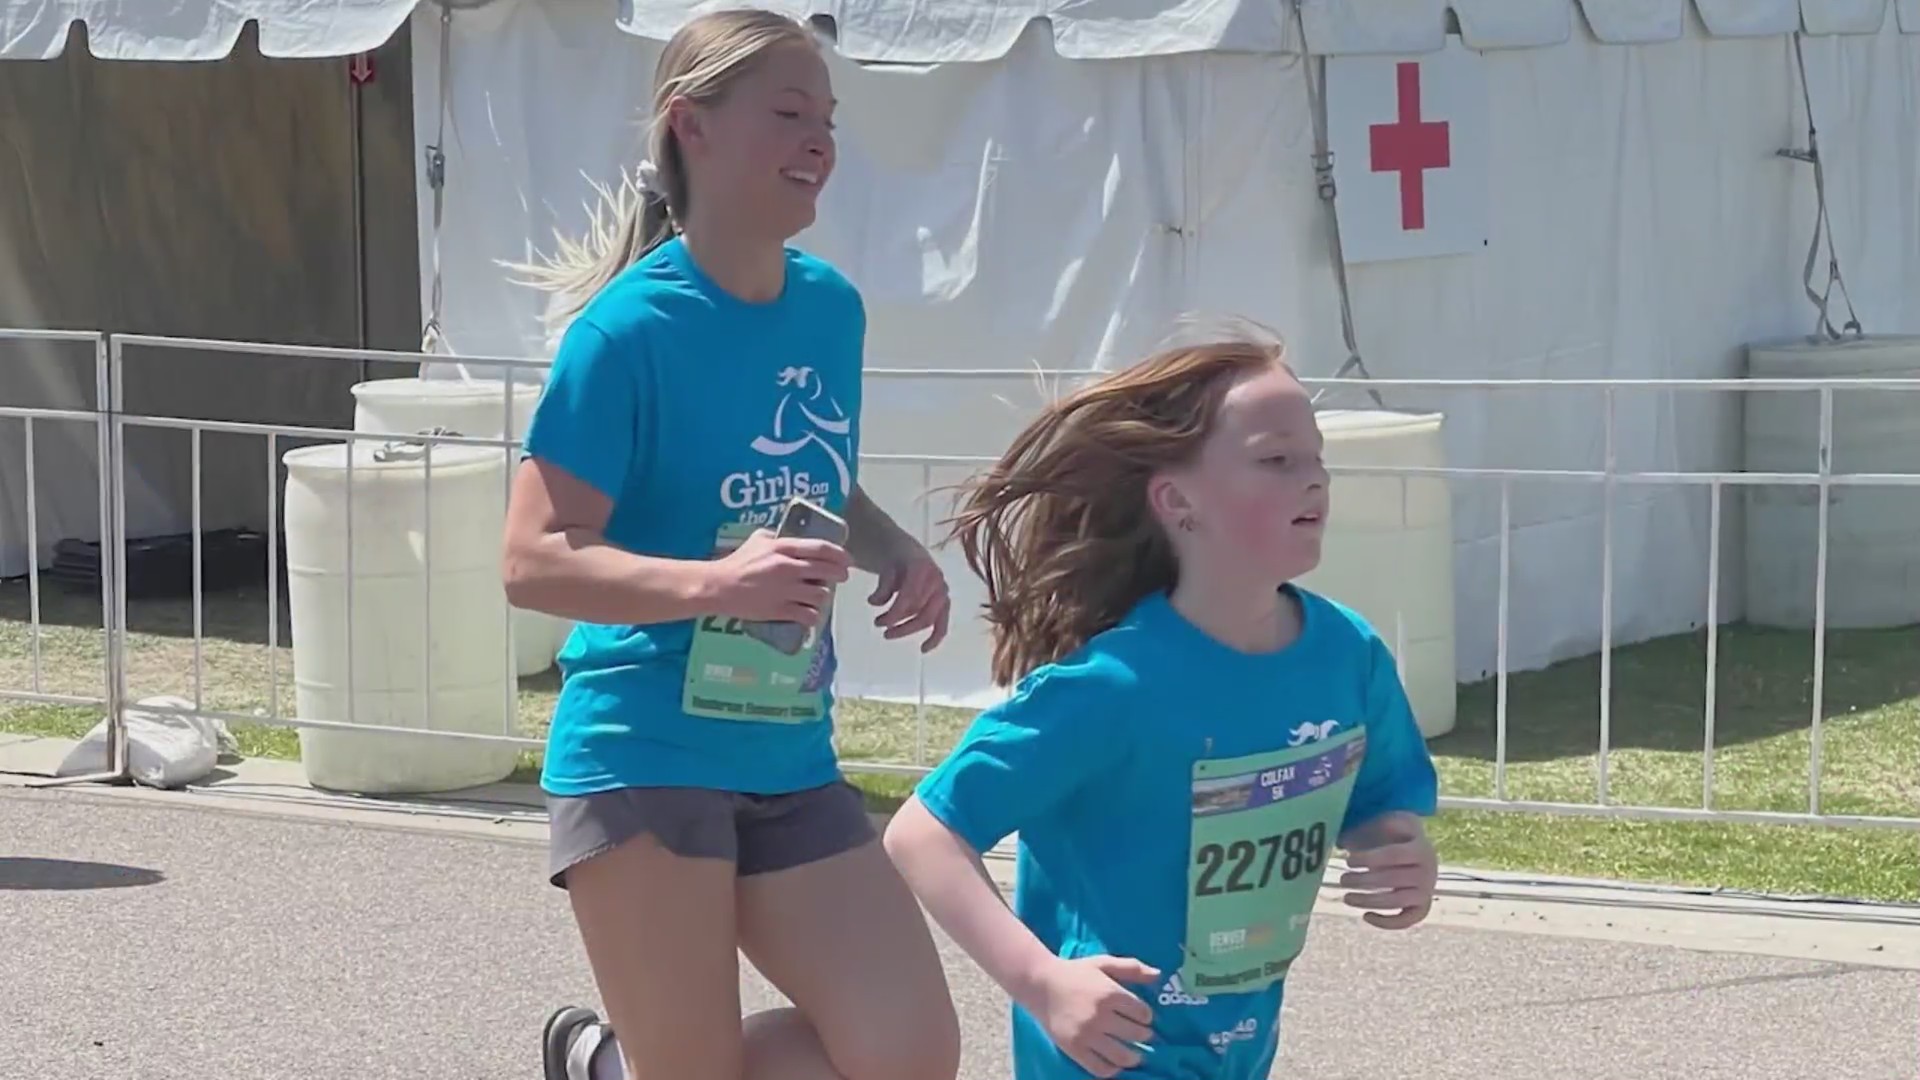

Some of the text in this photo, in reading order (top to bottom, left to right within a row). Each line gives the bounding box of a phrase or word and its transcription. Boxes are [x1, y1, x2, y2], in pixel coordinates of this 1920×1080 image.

[720, 466, 829, 509] Girls on
[739, 509, 767, 525] the
[1261, 765, 1296, 787] COLFAX
[1272, 785, 1285, 800] 5K
[1195, 822, 1326, 897] 22789
